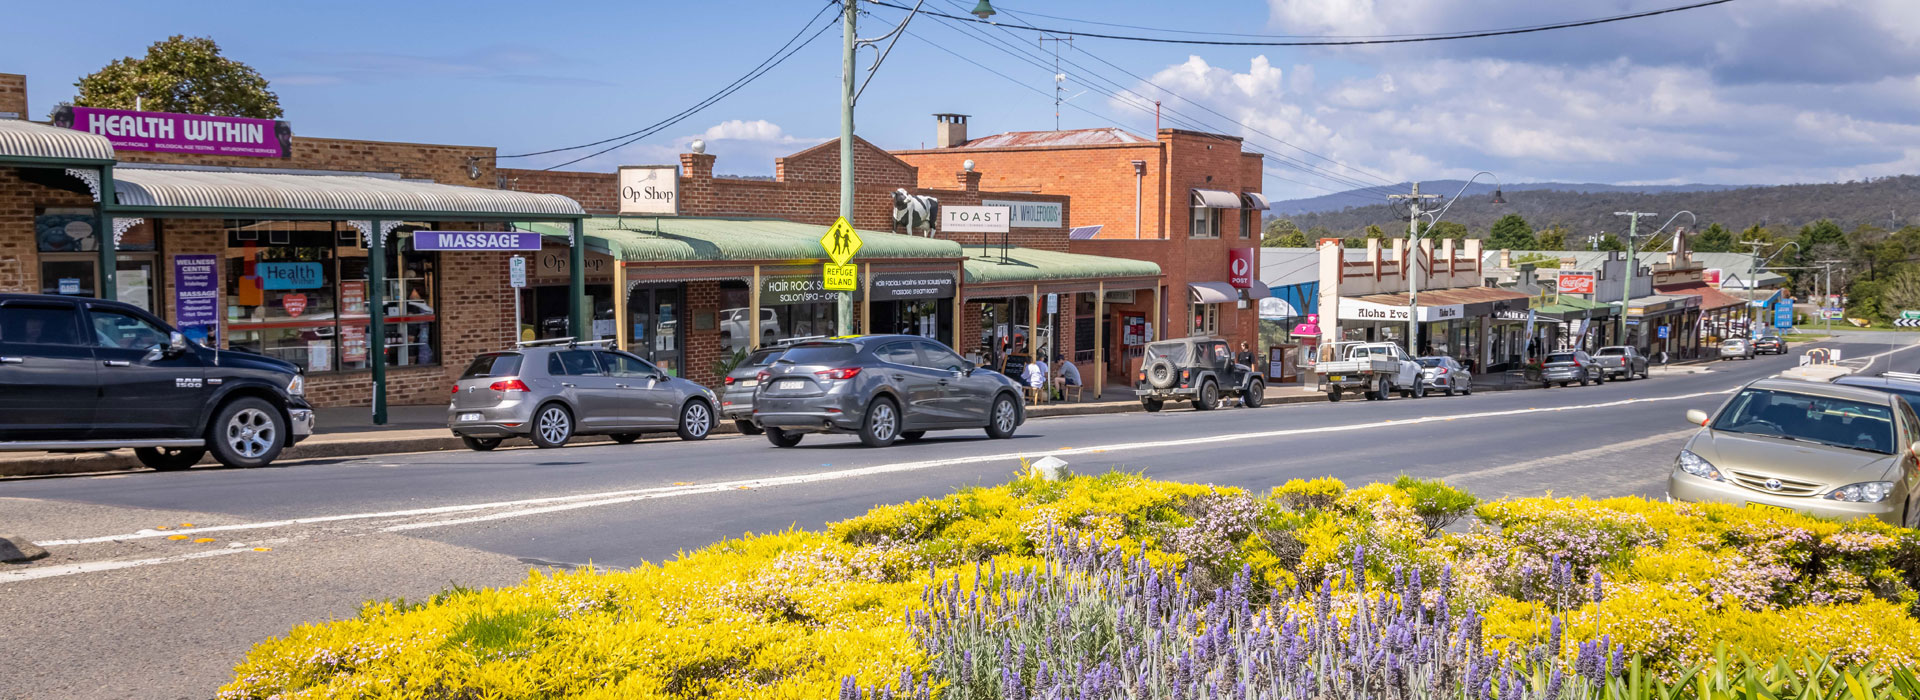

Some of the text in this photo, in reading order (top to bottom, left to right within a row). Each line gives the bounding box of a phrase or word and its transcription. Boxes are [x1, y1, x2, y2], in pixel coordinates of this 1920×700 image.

[89, 113, 263, 144] HEALTH WITHIN
[155, 142, 183, 150] BIOLOGICAL
[622, 185, 674, 203] Op Shop
[950, 211, 1002, 222] TOAST
[1021, 205, 1058, 222] WHOLEFOODS
[438, 233, 520, 249] MASSAGE
[543, 253, 604, 272] Op op
[267, 265, 315, 280] Health
[826, 267, 854, 277] REFUGE
[790, 280, 815, 291] ROCK
[826, 277, 853, 286] ISLAND
[1358, 308, 1408, 319] Aloha Eve
[1439, 308, 1448, 317] Aloha
